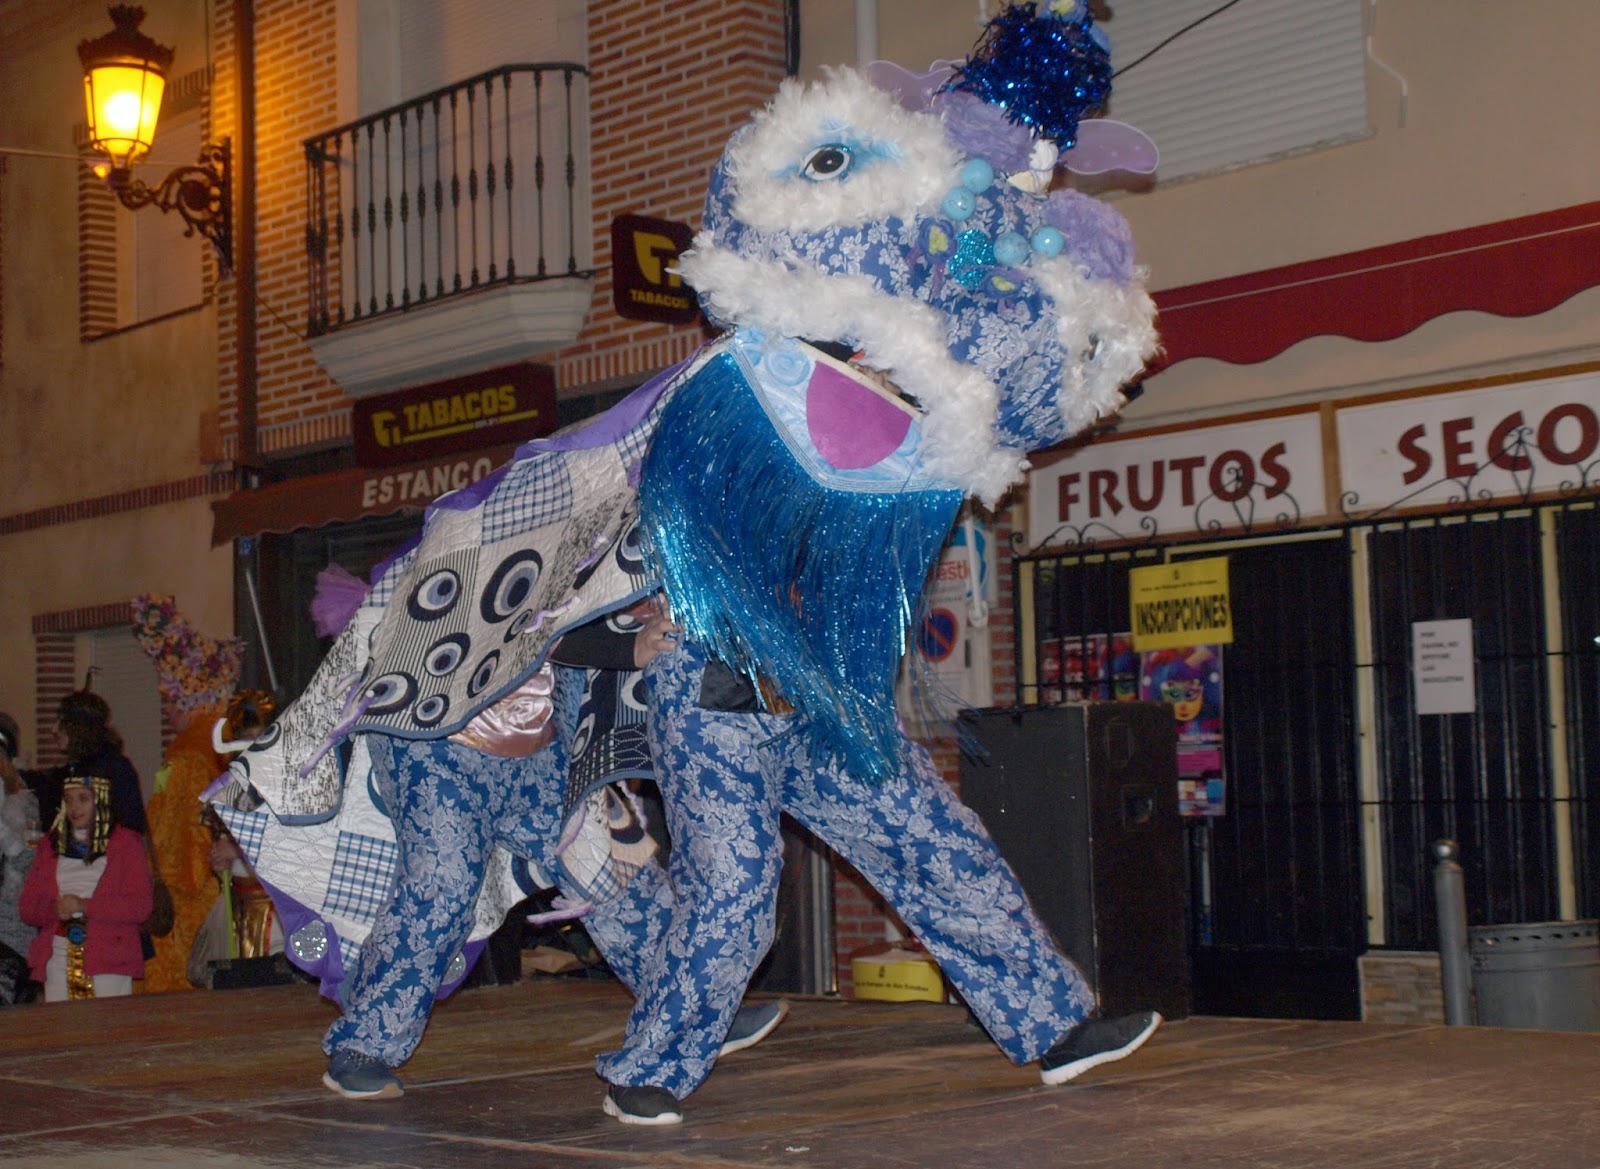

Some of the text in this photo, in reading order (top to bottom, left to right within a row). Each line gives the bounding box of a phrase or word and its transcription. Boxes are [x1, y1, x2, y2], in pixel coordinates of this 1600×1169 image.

[629, 289, 690, 309] TABACOS
[404, 384, 516, 431] TABACOS
[362, 457, 493, 508] ESTANCO
[1058, 403, 1600, 521] FRUTOS SECO
[1134, 594, 1228, 636] INSCRIPCIONES
